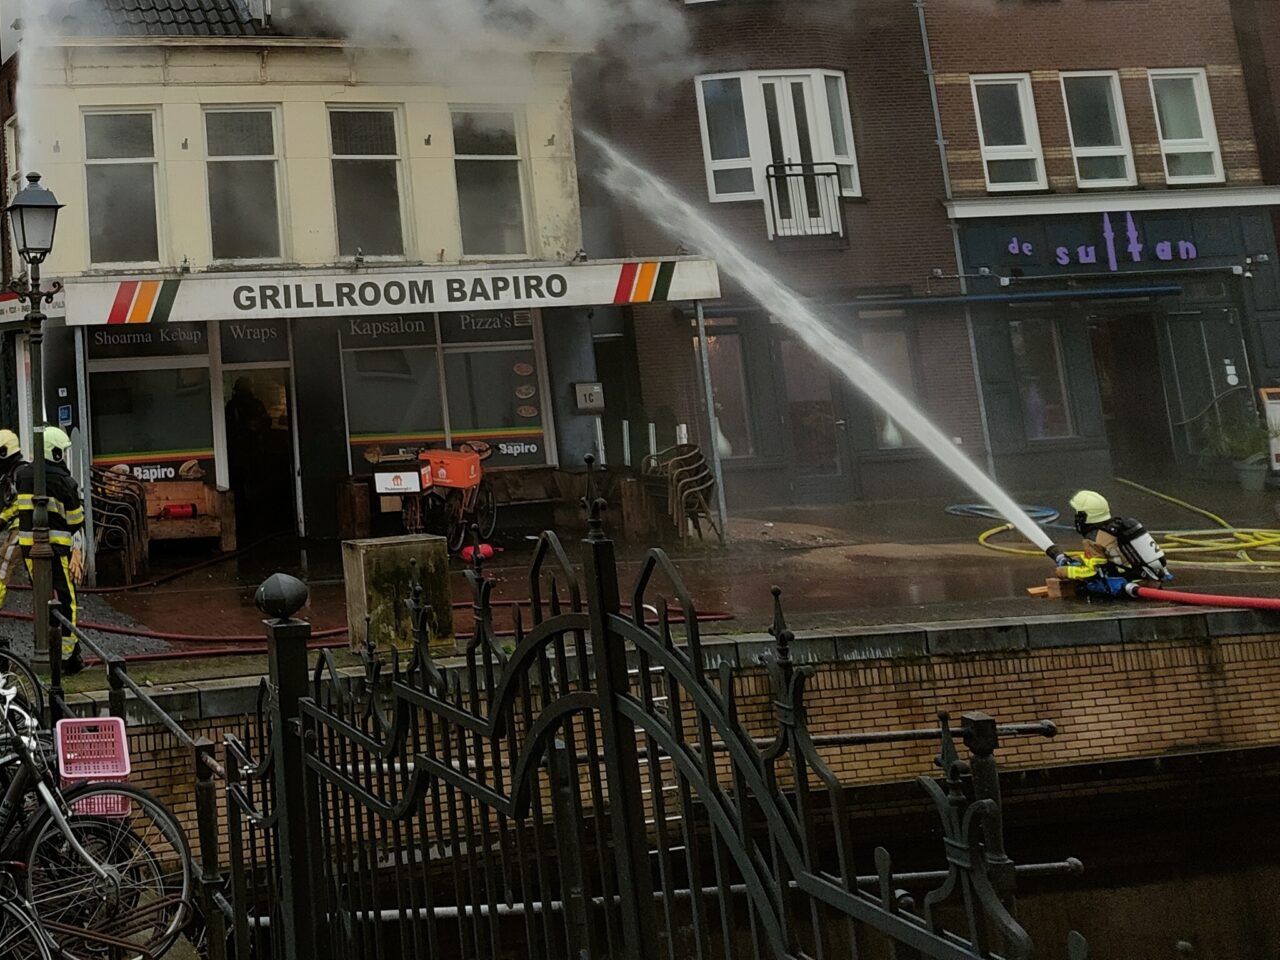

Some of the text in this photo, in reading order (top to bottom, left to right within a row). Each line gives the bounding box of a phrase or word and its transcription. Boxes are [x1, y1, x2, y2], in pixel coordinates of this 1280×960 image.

[1008, 211, 1197, 271] de sultan
[233, 274, 567, 311] GRILLROOM BAPIRO
[350, 316, 425, 338] Kapsalon
[460, 313, 512, 330] Pizza's
[94, 327, 201, 345] Shoarma Kebap
[230, 324, 278, 342] Wraps
[583, 392, 594, 403] 1C
[498, 442, 538, 456] Bapiro
[133, 465, 175, 483] Bapiro
